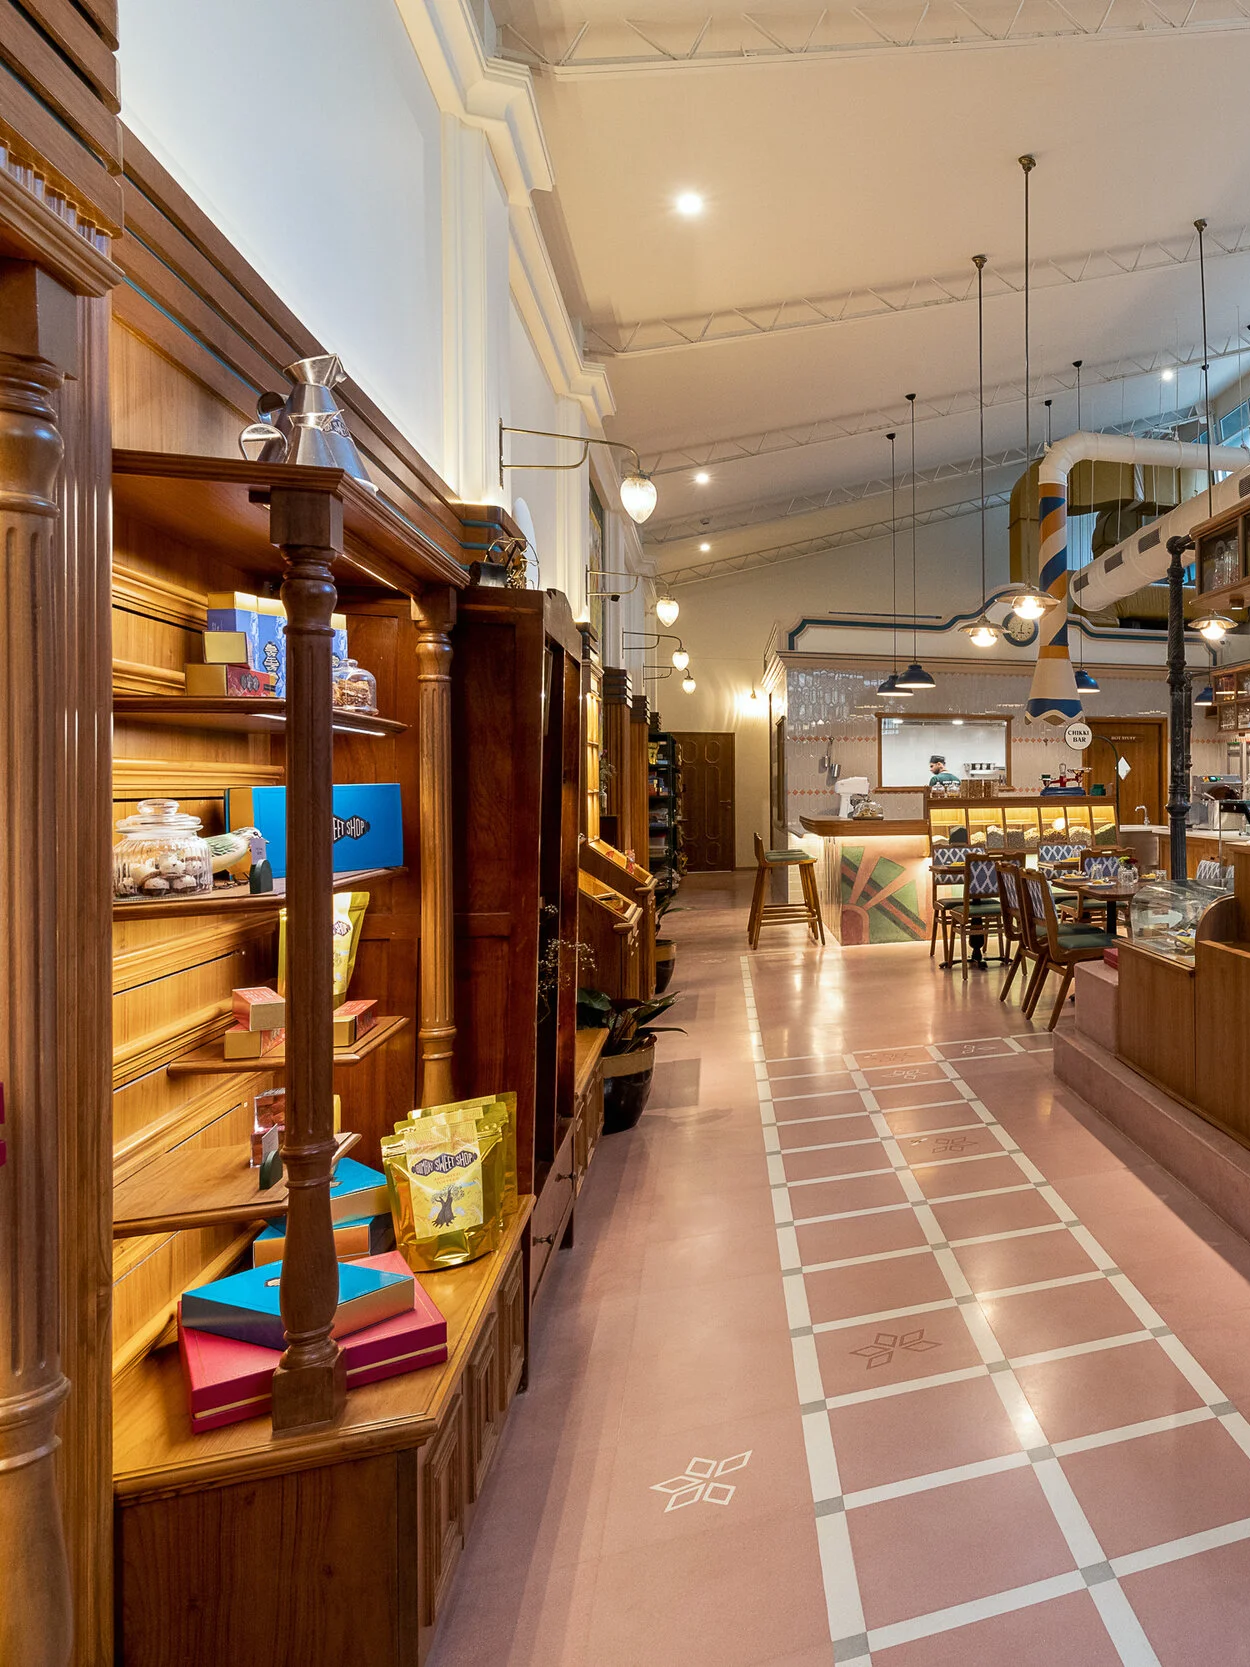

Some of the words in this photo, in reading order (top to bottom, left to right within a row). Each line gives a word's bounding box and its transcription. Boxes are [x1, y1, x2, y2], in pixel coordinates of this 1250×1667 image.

[333, 818, 345, 840] EET
[346, 818, 364, 838] SHOP
[434, 1154, 455, 1172] SWEET
[456, 1152, 473, 1166] SHOP
